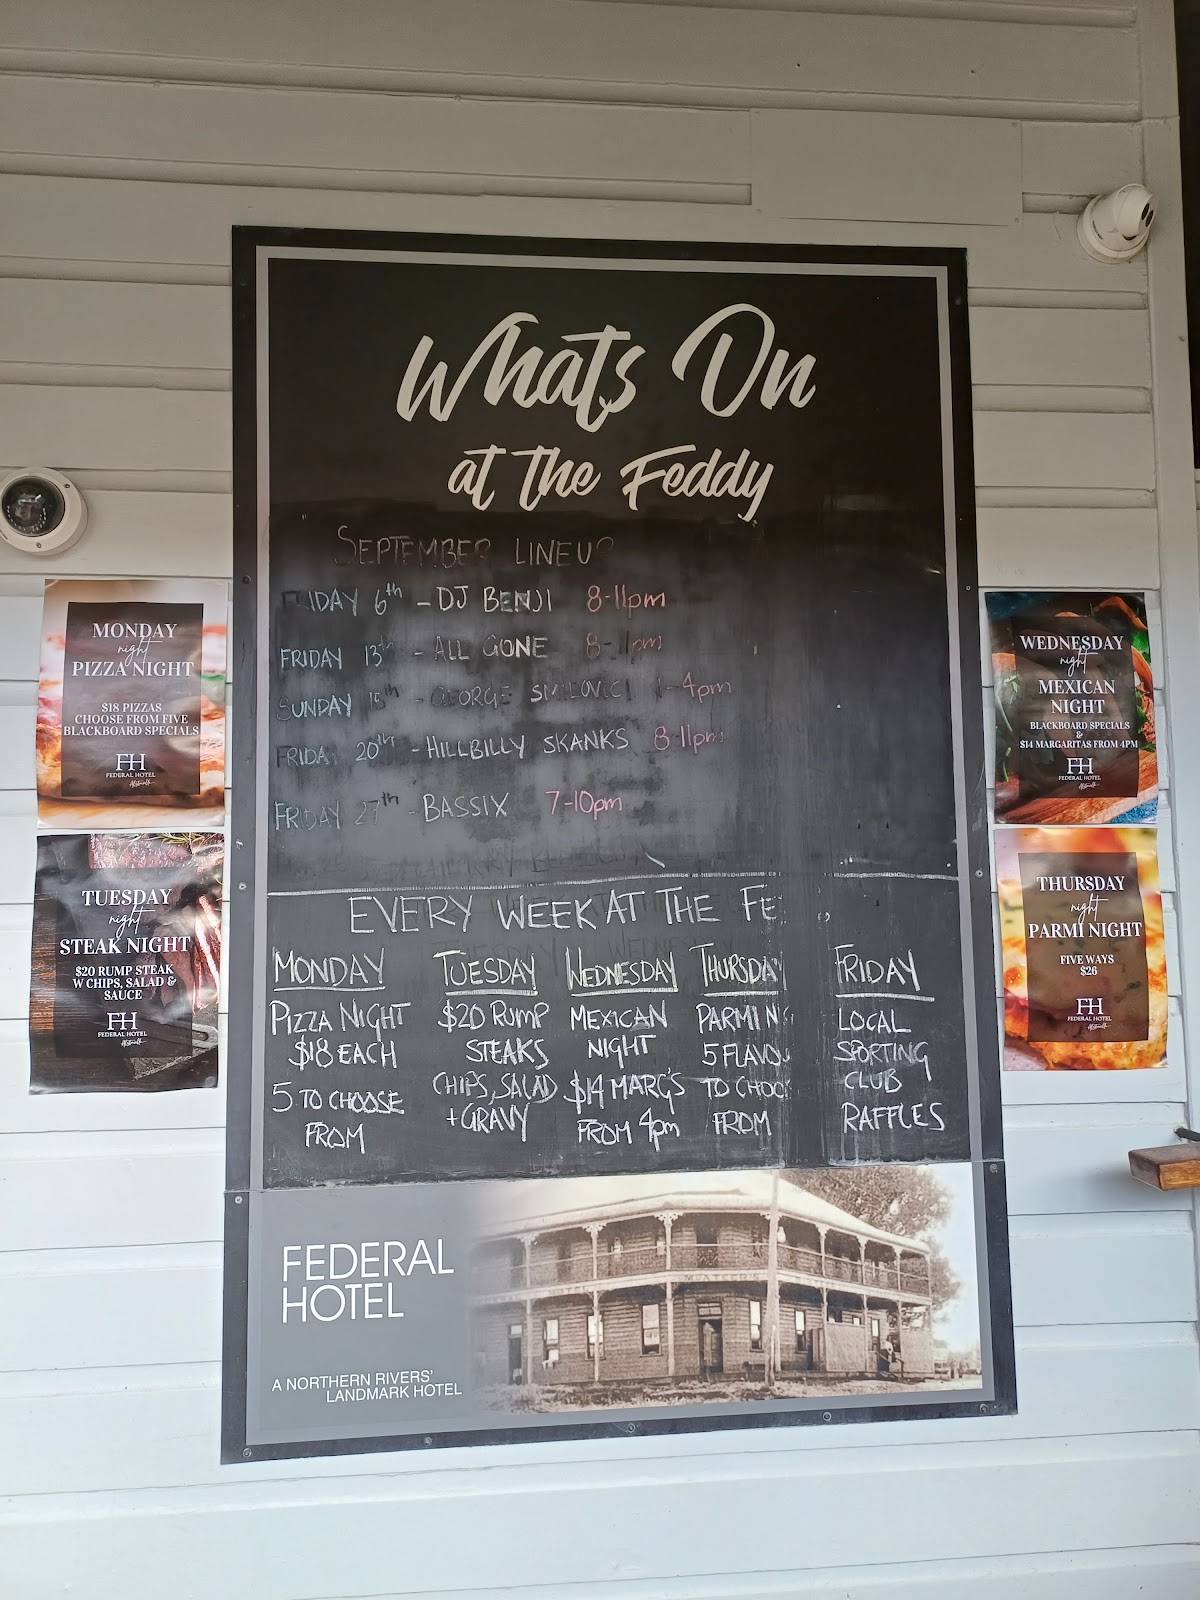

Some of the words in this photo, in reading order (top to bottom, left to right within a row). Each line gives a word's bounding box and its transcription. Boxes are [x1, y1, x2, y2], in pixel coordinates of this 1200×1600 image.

[396, 311, 646, 433] Whats
[671, 303, 817, 418] On
[447, 444, 507, 511] at
[620, 444, 774, 522] Feddy
[281, 587, 358, 616] FIDAY
[374, 582, 402, 615] 6th
[436, 586, 468, 611] DJ
[484, 587, 552, 612] BENJI
[586, 585, 666, 618] 8-11pm
[92, 623, 177, 638] MONDAY
[1020, 635, 1124, 650] WEDNESDAY
[117, 636, 163, 666] night
[281, 648, 342, 670] FRIDAY
[434, 636, 469, 660] ALL
[483, 635, 549, 658] GONE
[1059, 645, 1098, 677] night
[71, 661, 129, 677] PIZZA
[132, 661, 194, 677] NIGHT
[1039, 679, 1115, 694] MEXICAN
[74, 714, 124, 724] CHOOSE
[126, 714, 159, 724] FROM
[162, 714, 188, 724] FIVE
[122, 703, 162, 713] PIZZAS
[276, 693, 351, 721] SUNDAY
[1051, 699, 1105, 714] NIGHT
[63, 725, 143, 736] BLACKBOARD
[145, 725, 200, 736] SPECIALS
[1030, 721, 1088, 730] BLACKBOARD
[1089, 721, 1130, 730] SPECIALS
[276, 746, 338, 769] FRIDA
[355, 733, 395, 761] 20th
[426, 735, 526, 759] HILLBILLY
[543, 728, 629, 754] SKANKS
[1035, 740, 1092, 749] MARGARITAS
[1093, 740, 1118, 749] FROM
[1119, 740, 1138, 749] 4PM
[274, 801, 342, 830] FRIDAY
[355, 792, 399, 825] 27th
[423, 792, 510, 823] BASSIX
[545, 790, 623, 820] 7-10pm
[82, 889, 172, 906] TUESDAY
[1036, 876, 1125, 891] THURSDAY
[109, 902, 155, 938] night
[348, 895, 473, 934] EVERY
[497, 895, 597, 930] WEEK
[606, 889, 645, 924] AT
[655, 886, 720, 923] THE
[1070, 894, 1109, 925] night
[1028, 923, 1084, 938] PARMI
[1088, 922, 1142, 938] NIGHT
[59, 938, 121, 955] STEAK
[126, 936, 190, 954] NIGHT
[1060, 955, 1083, 964] FIVE
[1085, 954, 1114, 964] WAYS
[75, 966, 95, 977] $20
[98, 966, 132, 976] RUMP
[135, 964, 174, 975] STEAK
[272, 947, 385, 985] MONDAY
[433, 950, 537, 990] TUESDAY
[565, 946, 678, 990] WEDNESDAY
[689, 943, 787, 990] THURSDAY
[833, 944, 920, 991] FRIDAY
[1080, 966, 1097, 976] $26
[72, 979, 84, 989] W
[86, 978, 123, 990] CHIPS,
[125, 977, 164, 988] SALAD
[167, 977, 177, 987] &
[104, 989, 142, 1000] SAUCE
[270, 1000, 332, 1035] PIZZA
[340, 998, 411, 1041] NIGHT
[437, 1000, 486, 1032] $20
[490, 1000, 550, 1030] RUMP
[570, 1000, 668, 1031] MEXICAN
[695, 1003, 759, 1033] PARMI
[837, 1009, 911, 1033] LOCAL
[289, 1035, 332, 1070] $18
[338, 1040, 397, 1068] EACH
[465, 1038, 549, 1070] STEAKS
[588, 1034, 656, 1069] NIGHT
[701, 1043, 719, 1067] 5
[833, 1041, 932, 1081] SPORTING
[563, 1070, 604, 1114] $14
[610, 1067, 685, 1114] MARG'S
[704, 1078, 729, 1100] TO
[844, 1069, 903, 1093] CLUB
[272, 1081, 292, 1112] 5
[299, 1088, 323, 1110] TO
[328, 1090, 405, 1115] CHOOSE
[578, 1119, 633, 1145] FROM
[639, 1107, 681, 1151] 4pm
[713, 1111, 772, 1136] FROM
[841, 1102, 944, 1134] RAFFLES
[305, 1121, 365, 1154] FROM
[282, 1238, 454, 1282] FEDERAL
[282, 1282, 404, 1323] HOTEL
[271, 1379, 282, 1391] A
[286, 1373, 371, 1390] NORTHERN
[375, 1370, 433, 1386] RIVERS'
[326, 1387, 410, 1403] LANDMARK
[413, 1383, 462, 1398] HOTEL
